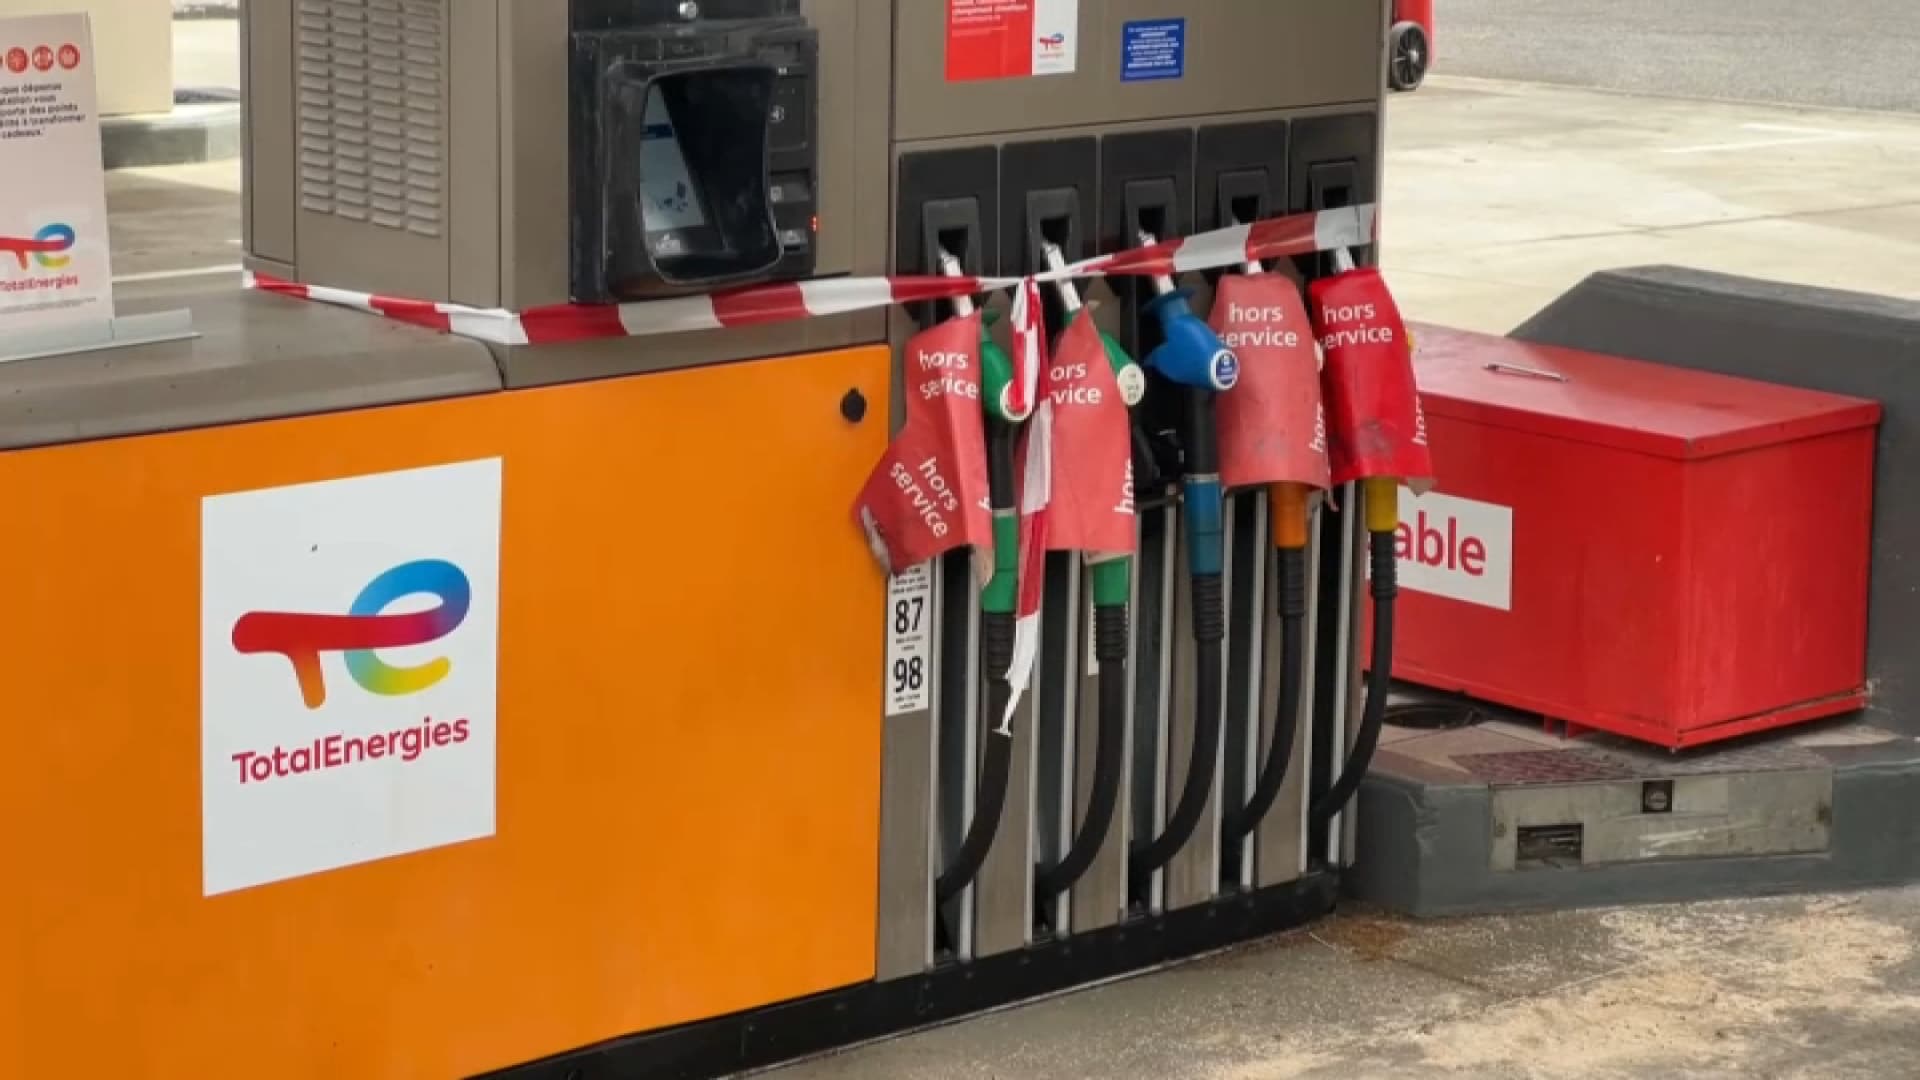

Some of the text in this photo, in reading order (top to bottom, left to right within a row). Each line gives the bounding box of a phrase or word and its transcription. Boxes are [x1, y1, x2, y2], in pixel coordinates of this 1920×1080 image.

[1229, 302, 1283, 322] hors
[1322, 303, 1376, 325] hors
[1321, 324, 1393, 350] ervice
[1050, 362, 1087, 382] ors
[889, 462, 948, 539] service
[918, 456, 958, 511] hors
[1394, 509, 1487, 577] able
[895, 596, 924, 635] 87
[893, 655, 924, 693] 98
[231, 715, 470, 784] TotalEnergies
